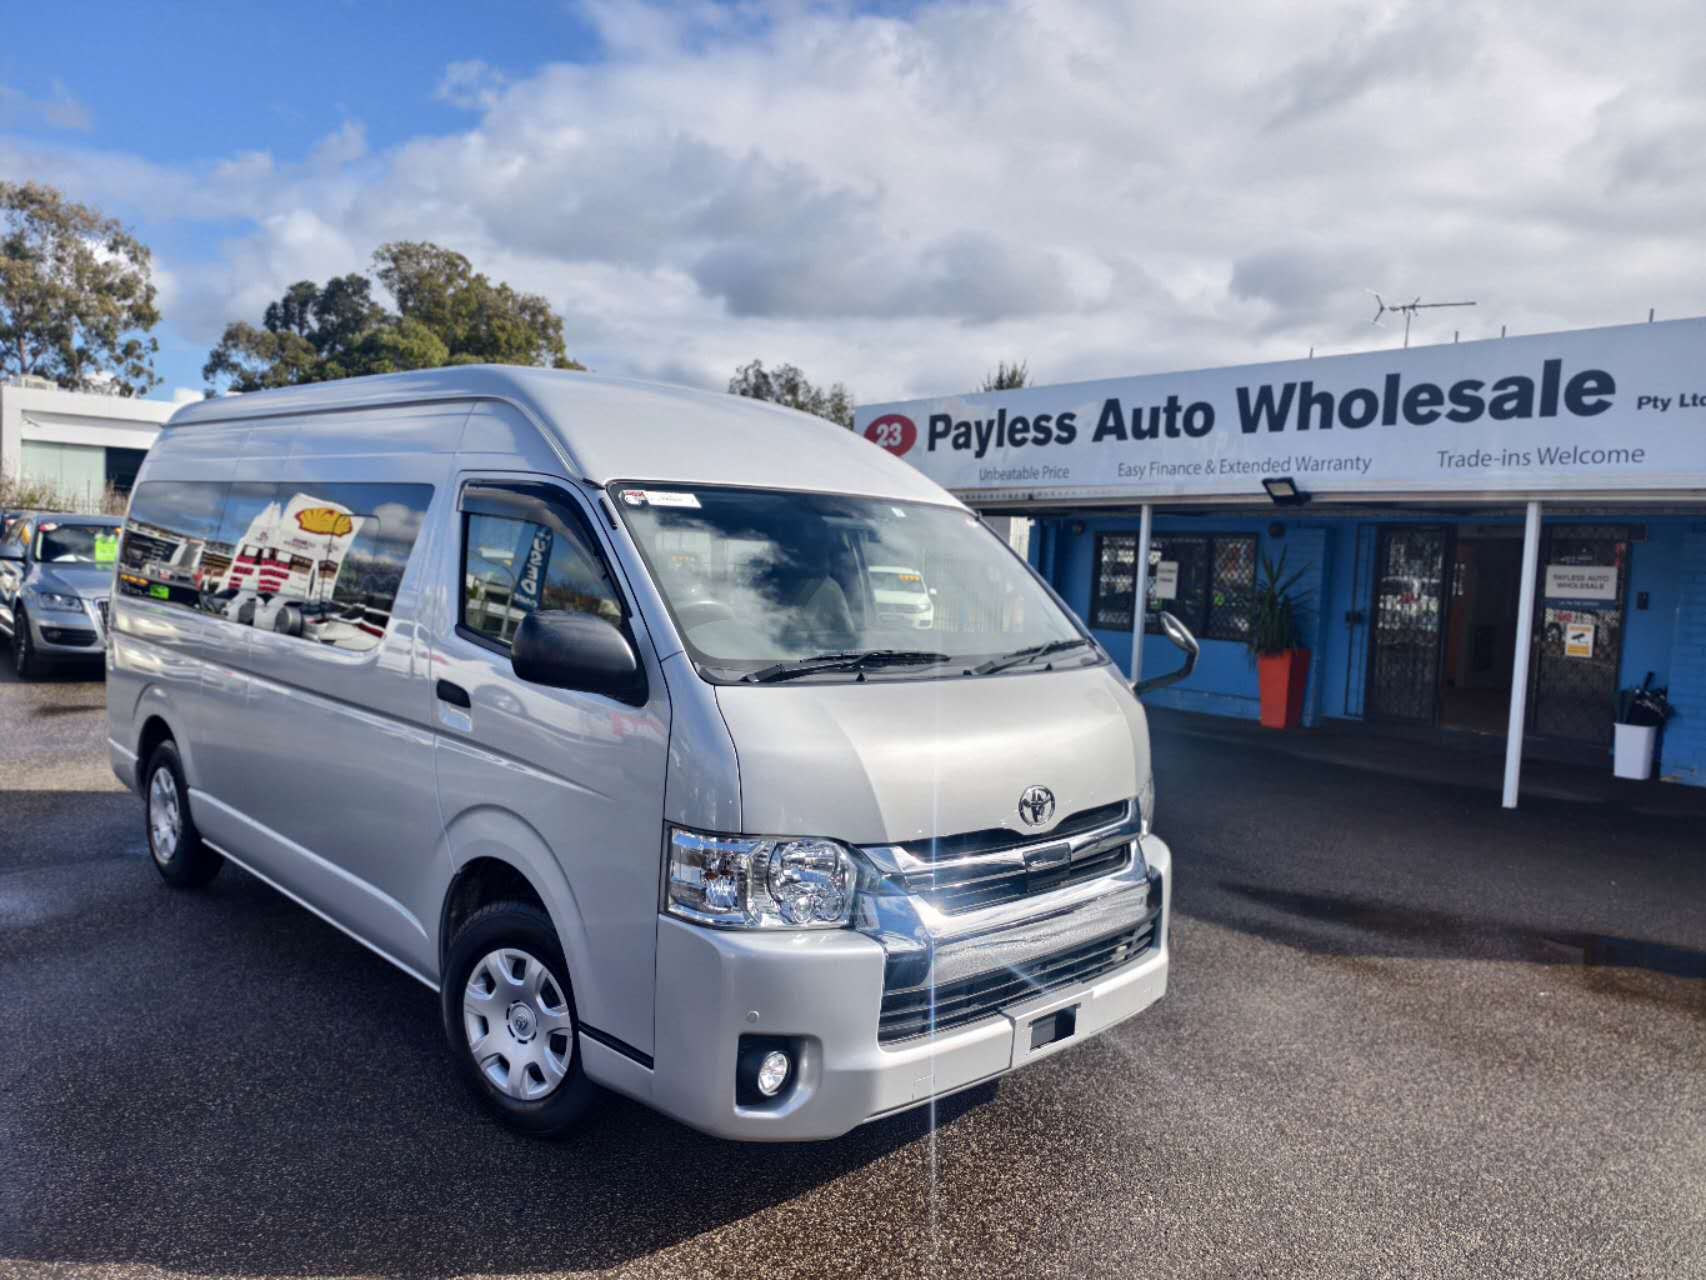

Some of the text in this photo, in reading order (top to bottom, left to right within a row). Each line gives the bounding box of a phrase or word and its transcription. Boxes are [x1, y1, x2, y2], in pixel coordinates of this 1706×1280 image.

[927, 408, 1078, 459] Payless
[1092, 395, 1215, 443] Auto
[1236, 358, 1616, 434] Wholesale
[1637, 395, 1672, 413] Pty
[876, 422, 902, 447] 23
[1117, 455, 1372, 480] Easy Finance & Extended Warranty
[1437, 445, 1646, 468] Trade-ins Welcome
[979, 465, 1070, 481] Unbeatable Price
